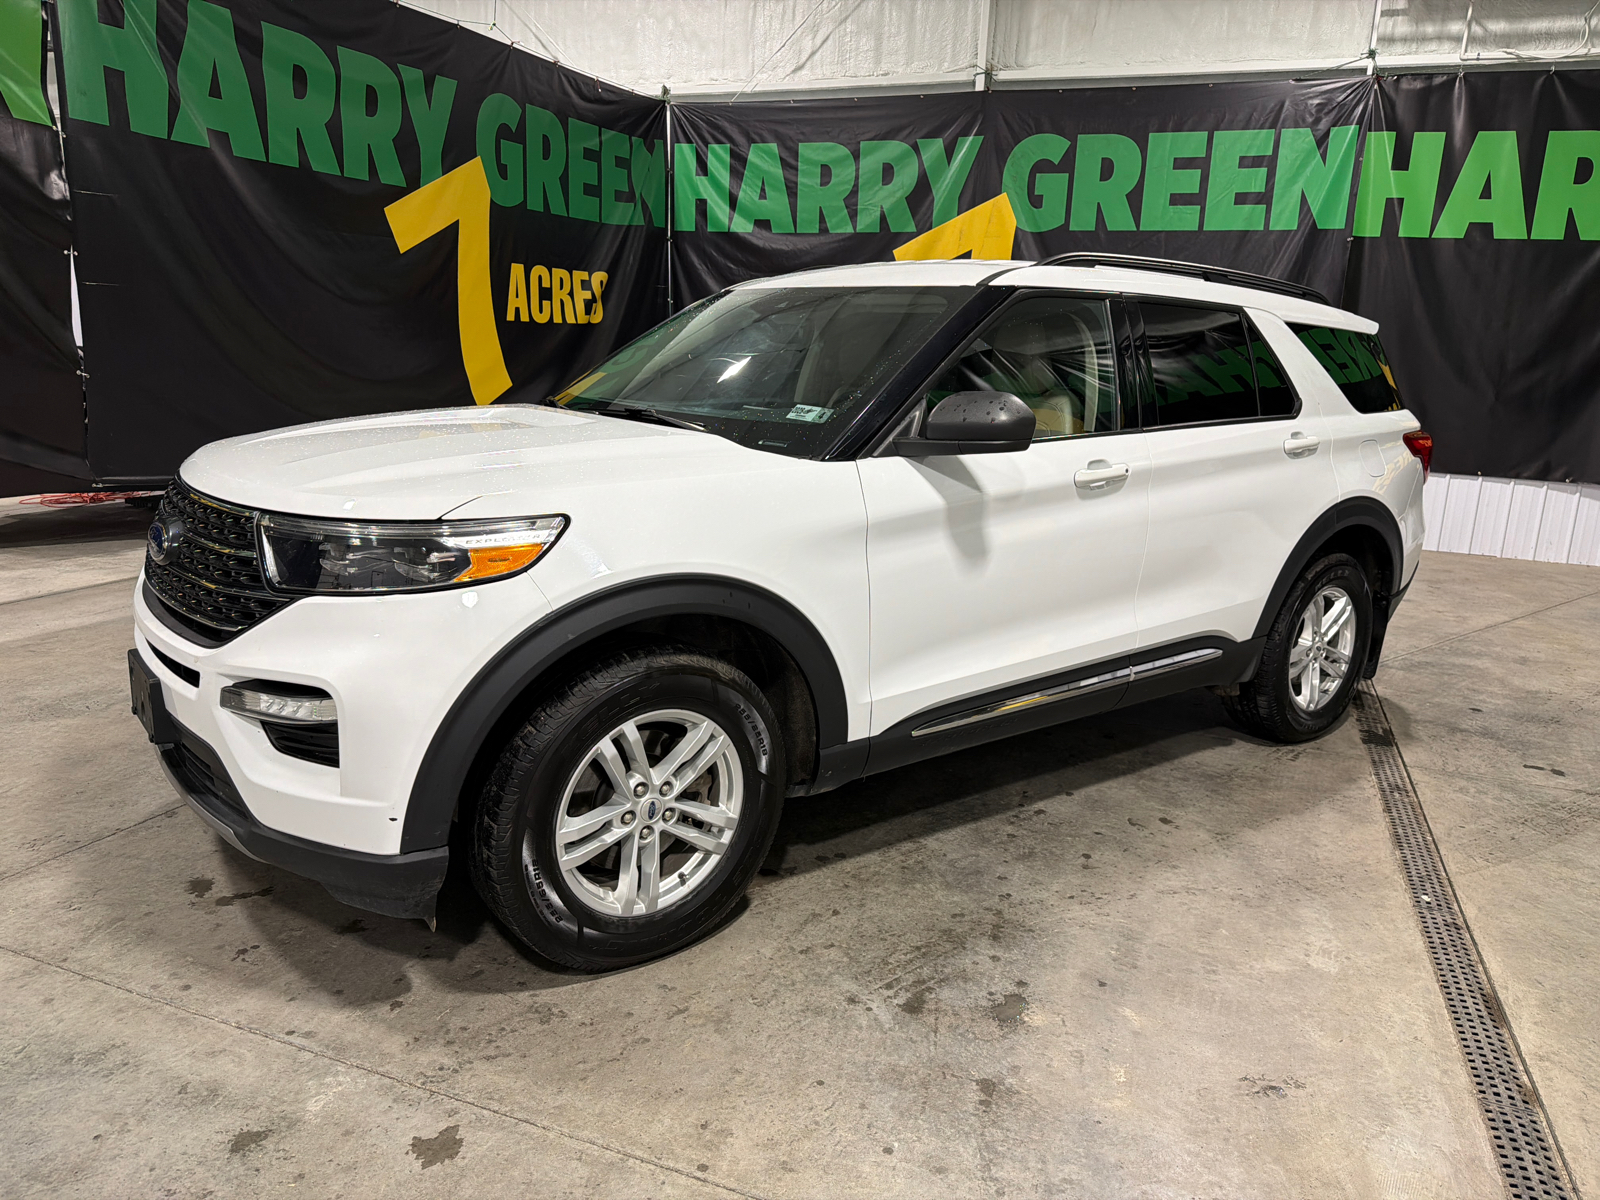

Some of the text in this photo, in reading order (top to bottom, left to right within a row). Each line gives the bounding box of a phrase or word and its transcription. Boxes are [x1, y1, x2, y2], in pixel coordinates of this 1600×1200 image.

[61, 0, 457, 188] HARRY
[475, 92, 666, 228] GREEN
[674, 135, 985, 234] HARRY
[1002, 125, 1359, 233] GREEN
[506, 262, 608, 324] ACRES
